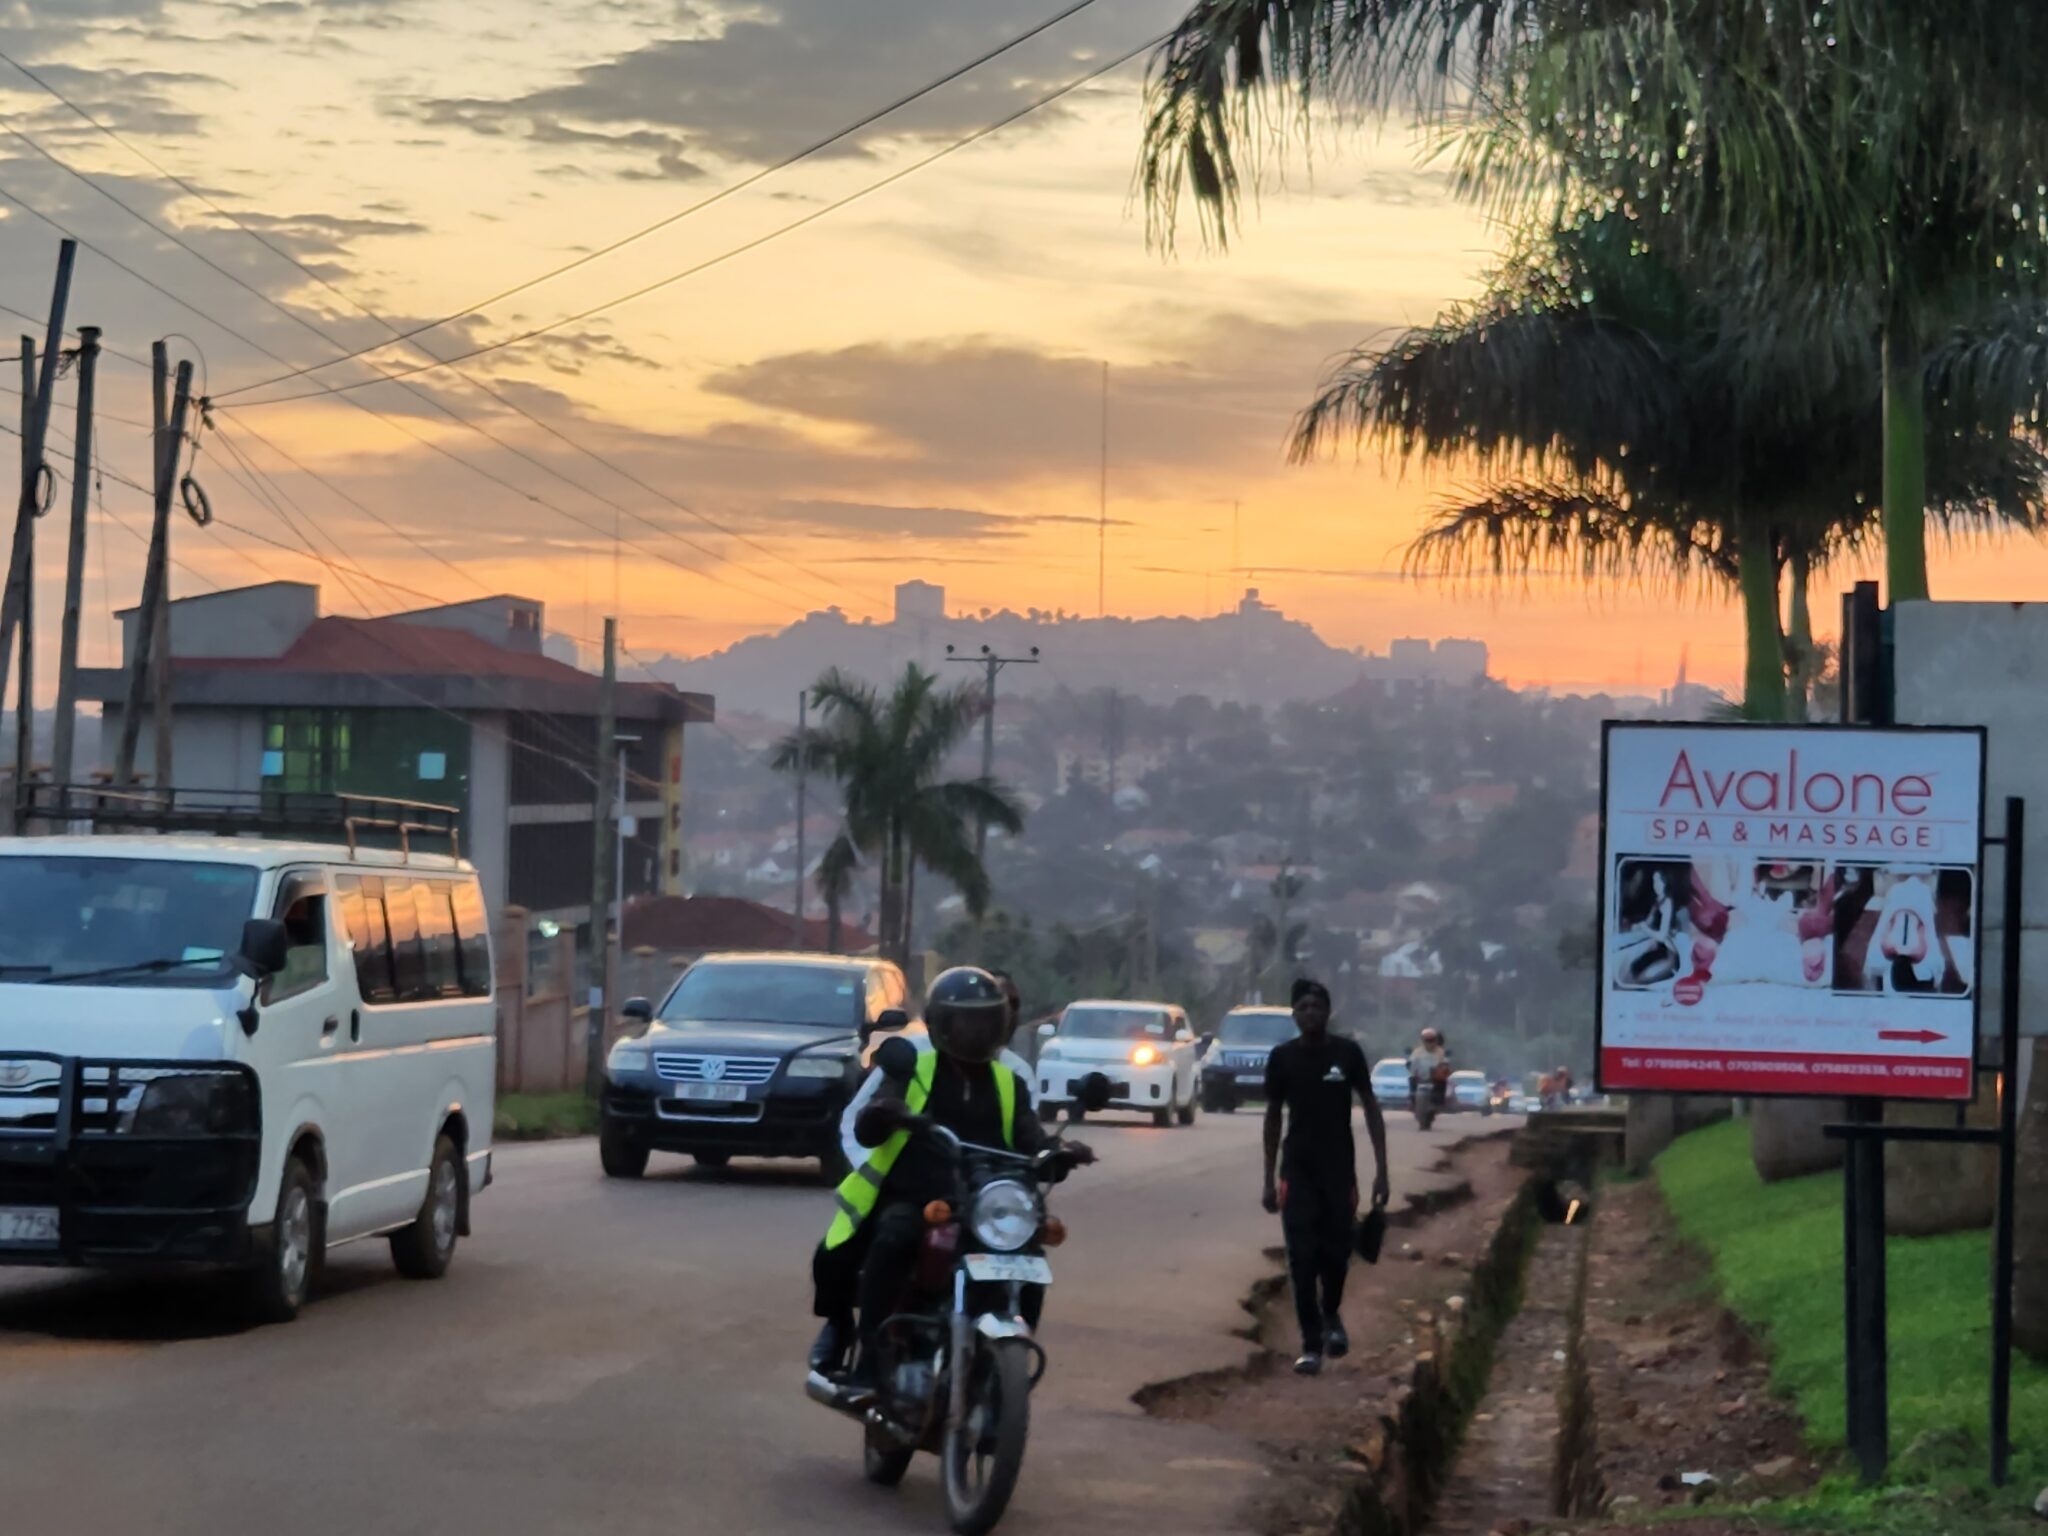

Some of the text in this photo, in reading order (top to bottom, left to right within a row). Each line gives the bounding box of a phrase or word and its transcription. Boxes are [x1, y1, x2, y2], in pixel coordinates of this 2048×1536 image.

[1658, 748, 1935, 816] Avalone
[1652, 818, 1932, 848] SPA & MASSAGE
